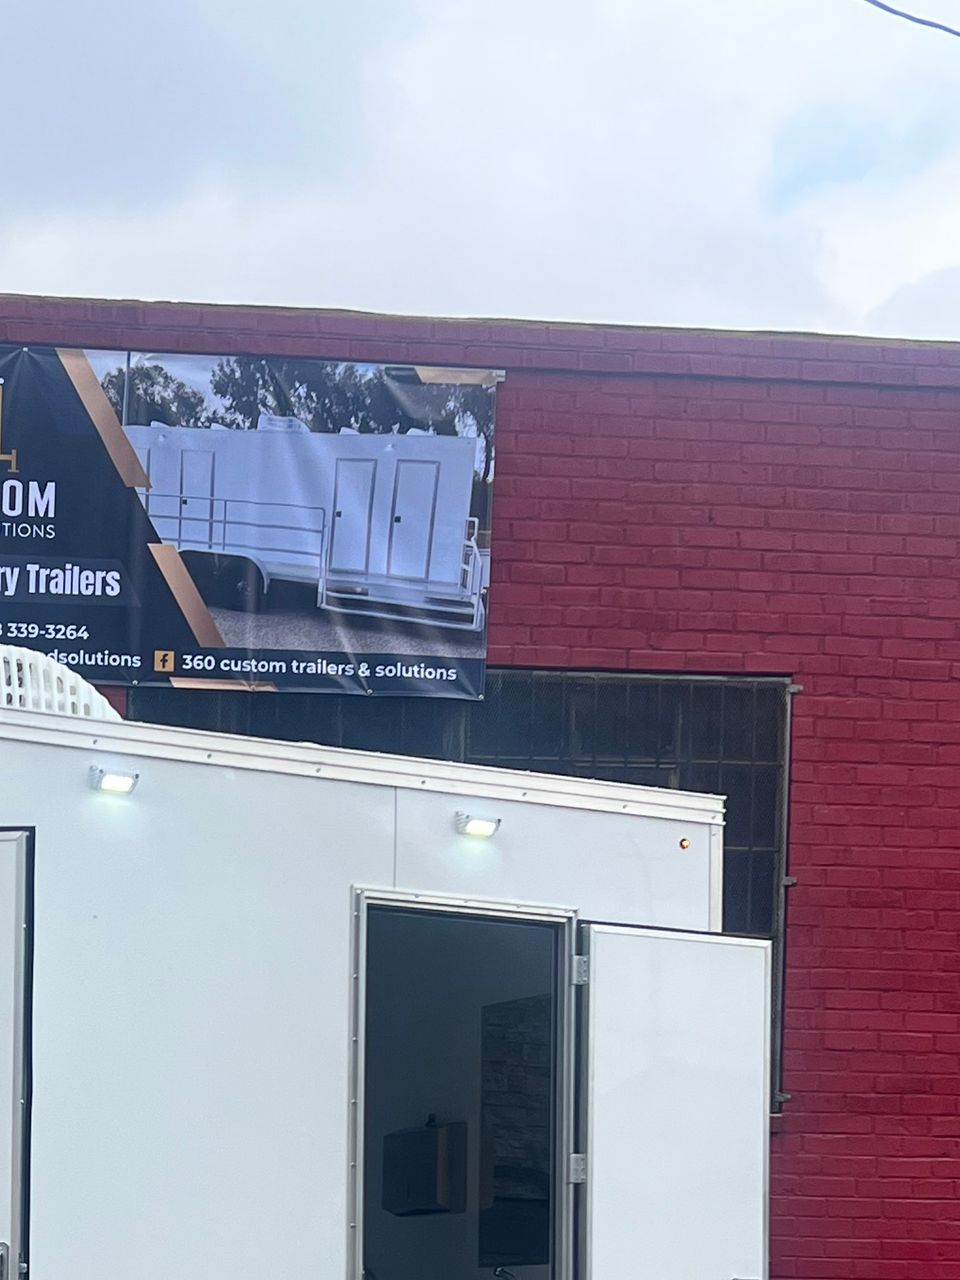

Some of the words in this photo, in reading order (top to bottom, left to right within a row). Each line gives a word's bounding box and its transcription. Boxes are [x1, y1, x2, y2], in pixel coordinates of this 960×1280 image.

[26, 563, 121, 597] Trailers
[6, 622, 90, 640] 339-3264
[181, 655, 216, 671] 360
[219, 659, 288, 674] custom
[290, 658, 354, 677] trailers
[357, 662, 372, 678] &
[375, 662, 458, 682] solutions
